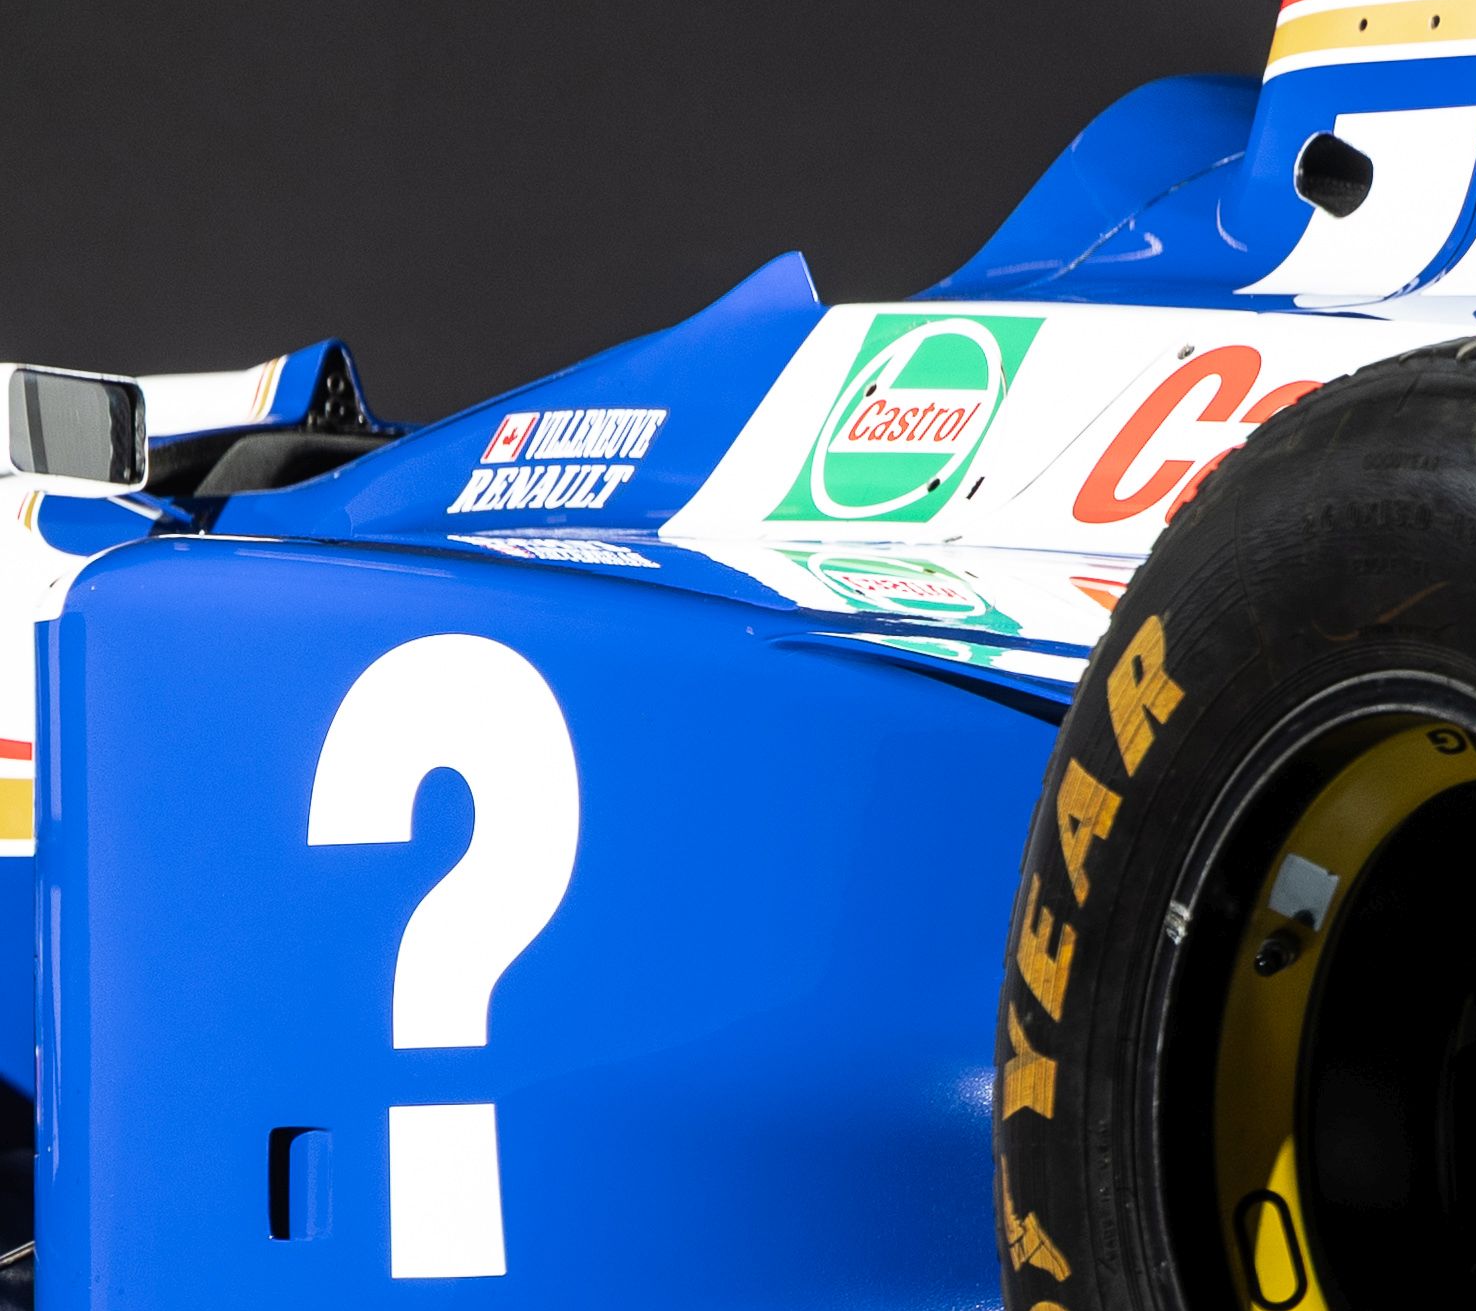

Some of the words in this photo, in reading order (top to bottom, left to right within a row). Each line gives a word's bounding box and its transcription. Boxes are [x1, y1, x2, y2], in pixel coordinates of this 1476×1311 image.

[525, 408, 668, 461] VILLENEUVE
[847, 399, 981, 443] Castrol
[446, 464, 636, 515] RENAULT
